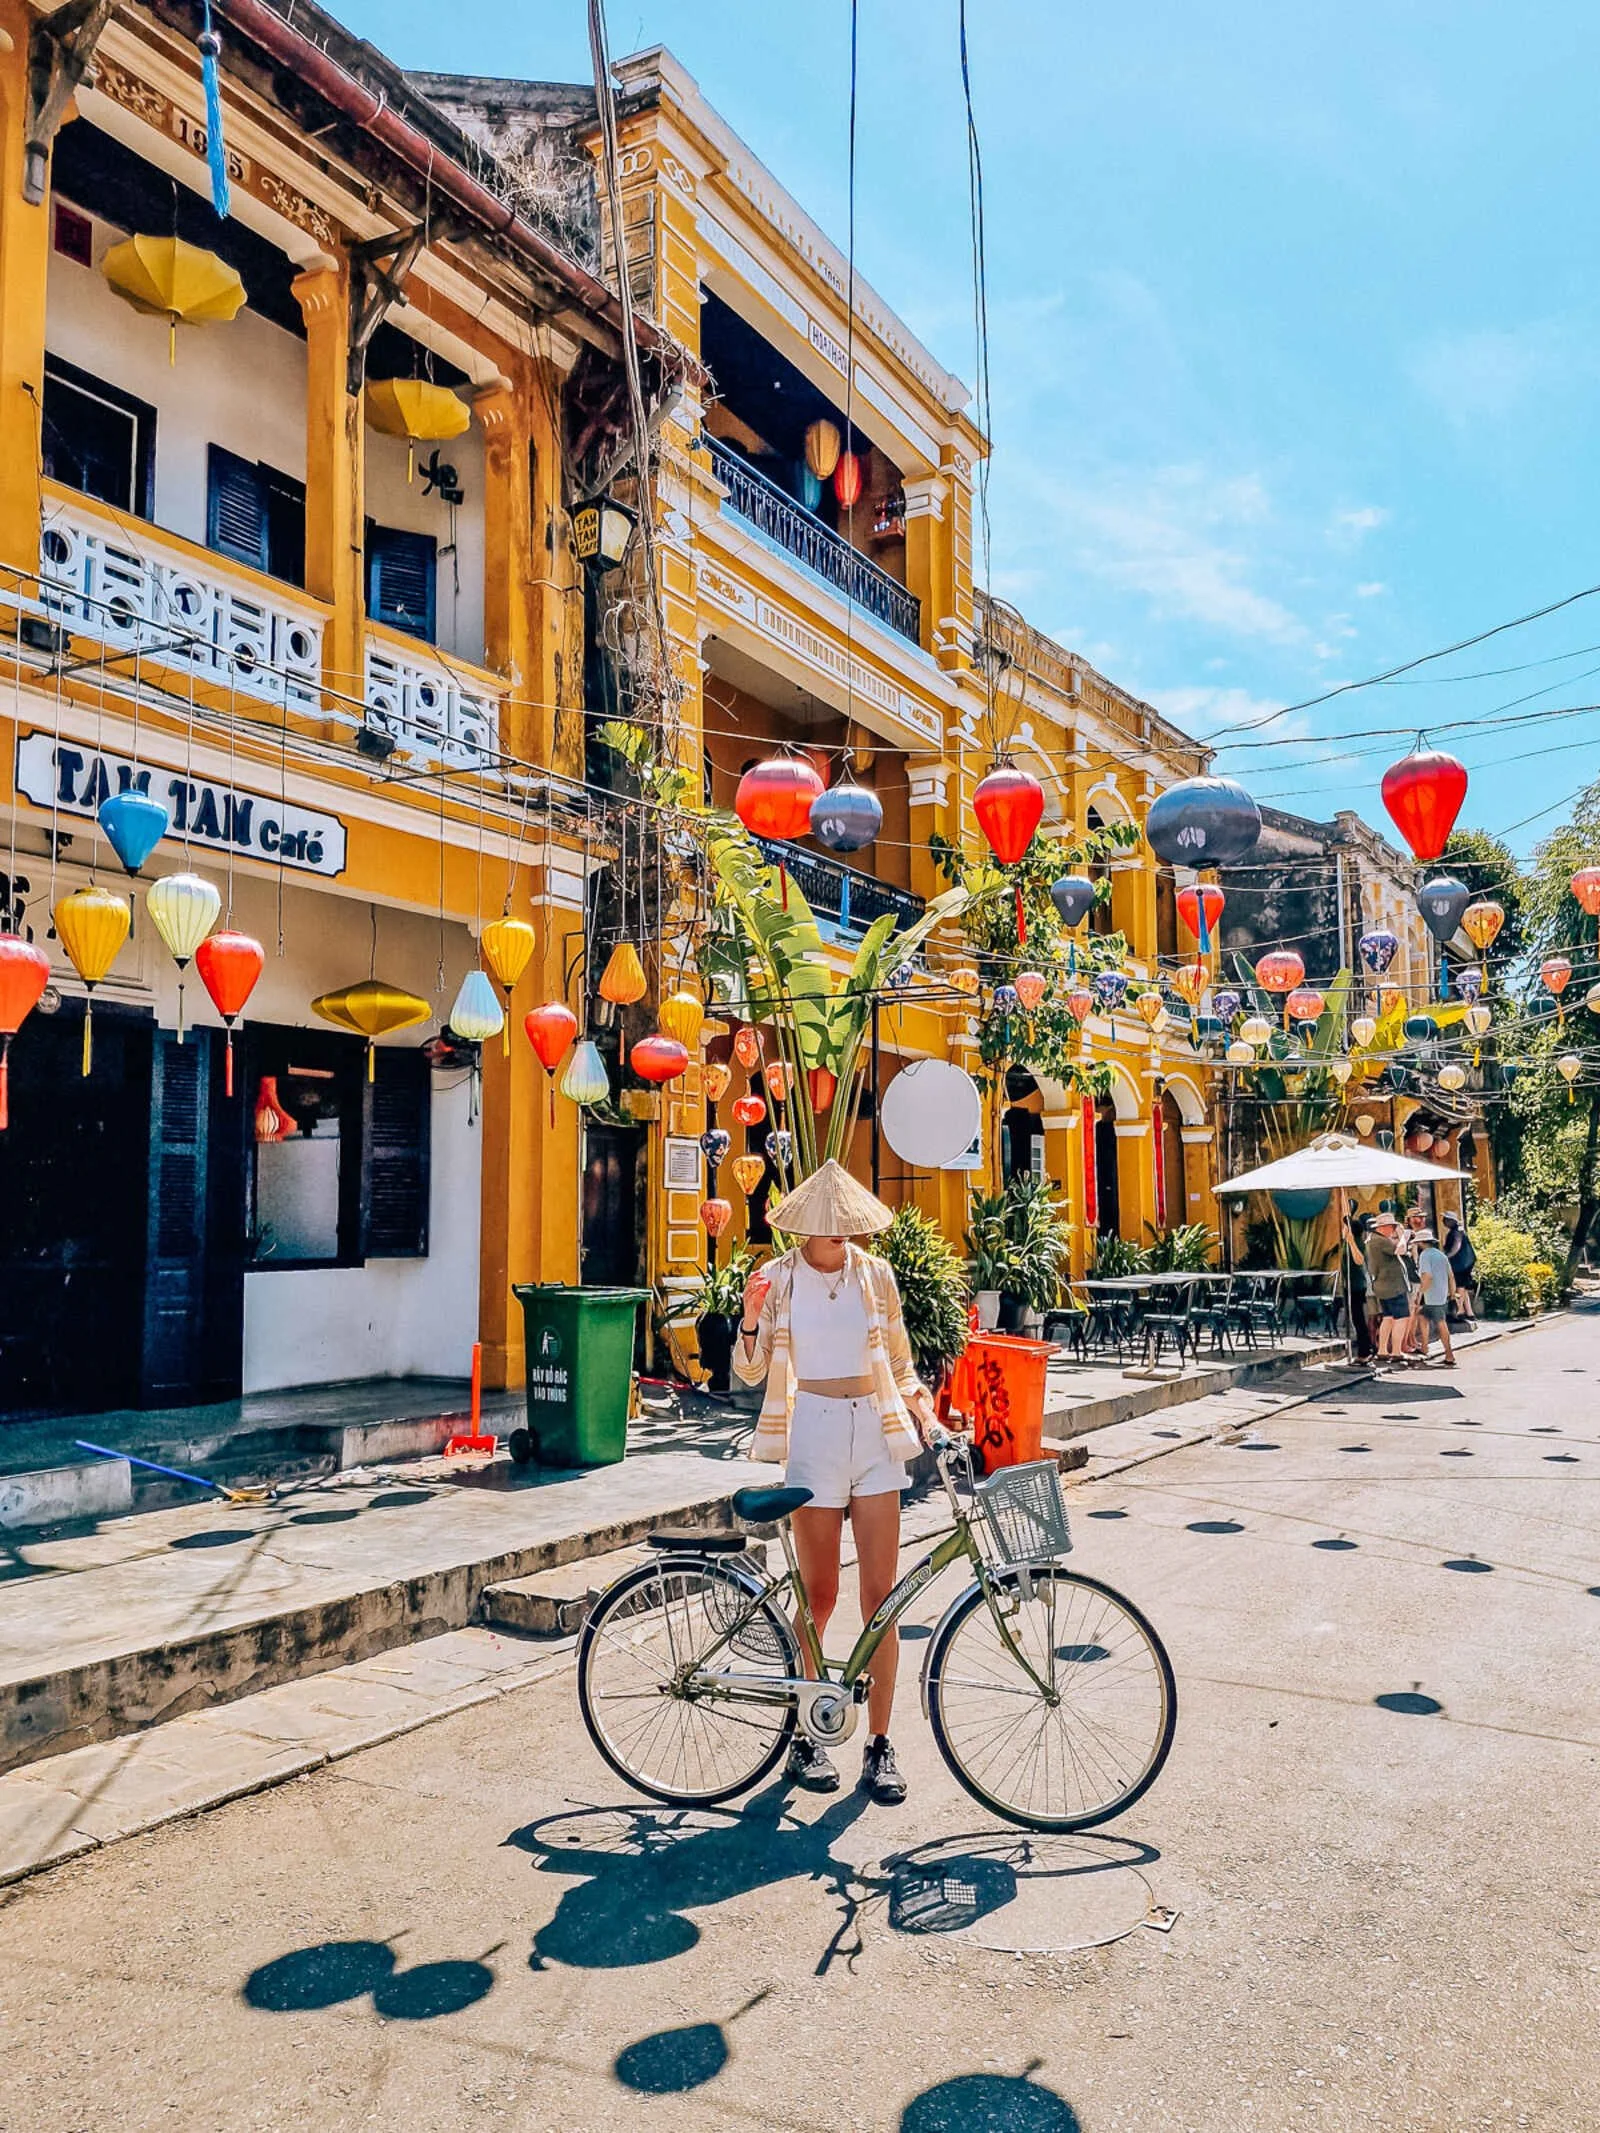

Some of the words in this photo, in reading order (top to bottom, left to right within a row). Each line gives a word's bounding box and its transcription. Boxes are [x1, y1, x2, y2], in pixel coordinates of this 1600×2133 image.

[179, 118, 243, 180] 195
[168, 779, 254, 846] TAM
[260, 820, 324, 864] Café
